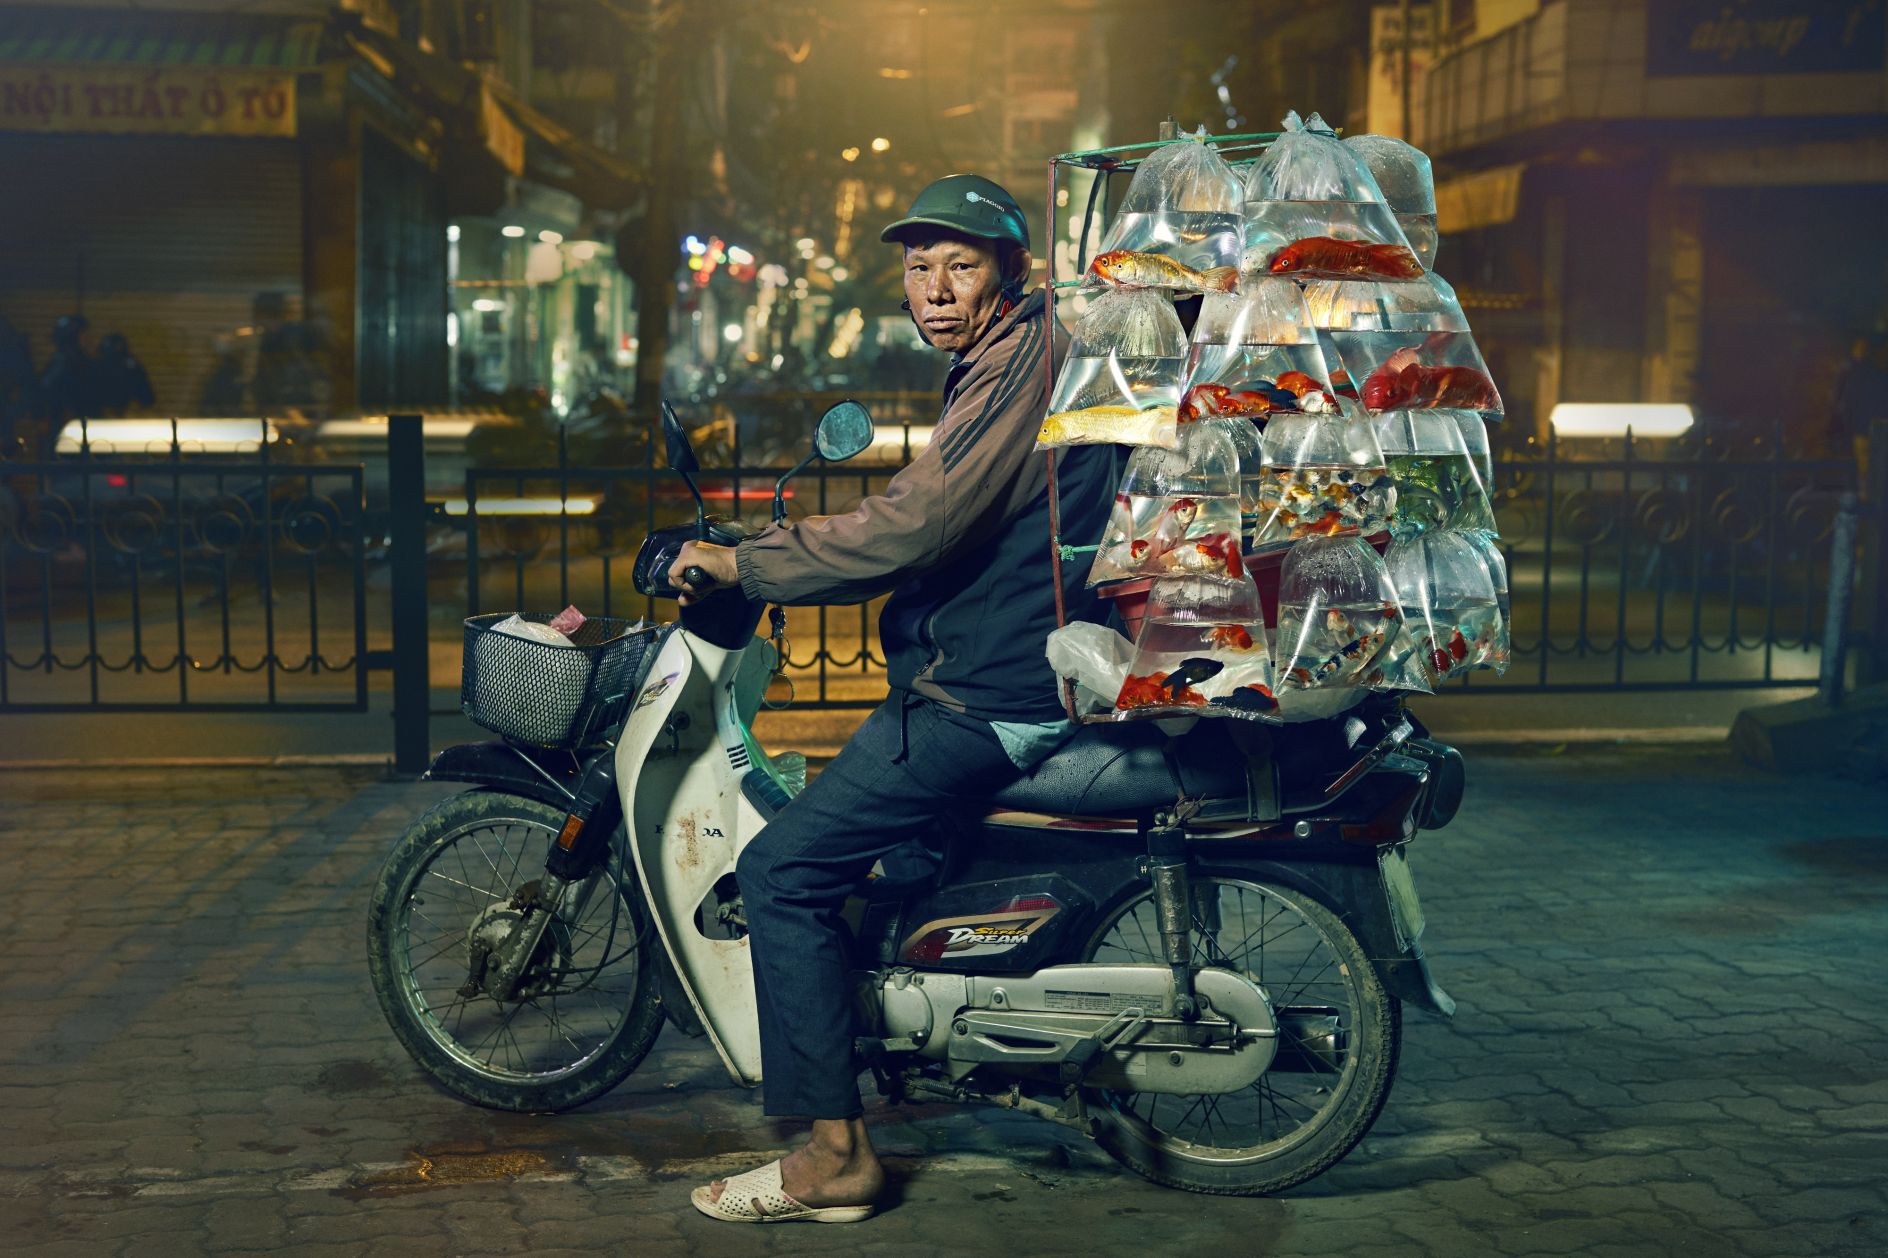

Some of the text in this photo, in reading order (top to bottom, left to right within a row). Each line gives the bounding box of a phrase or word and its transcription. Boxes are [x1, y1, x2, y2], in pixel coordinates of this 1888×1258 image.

[3, 70, 286, 123] NỘI THẤT Ô TÔ
